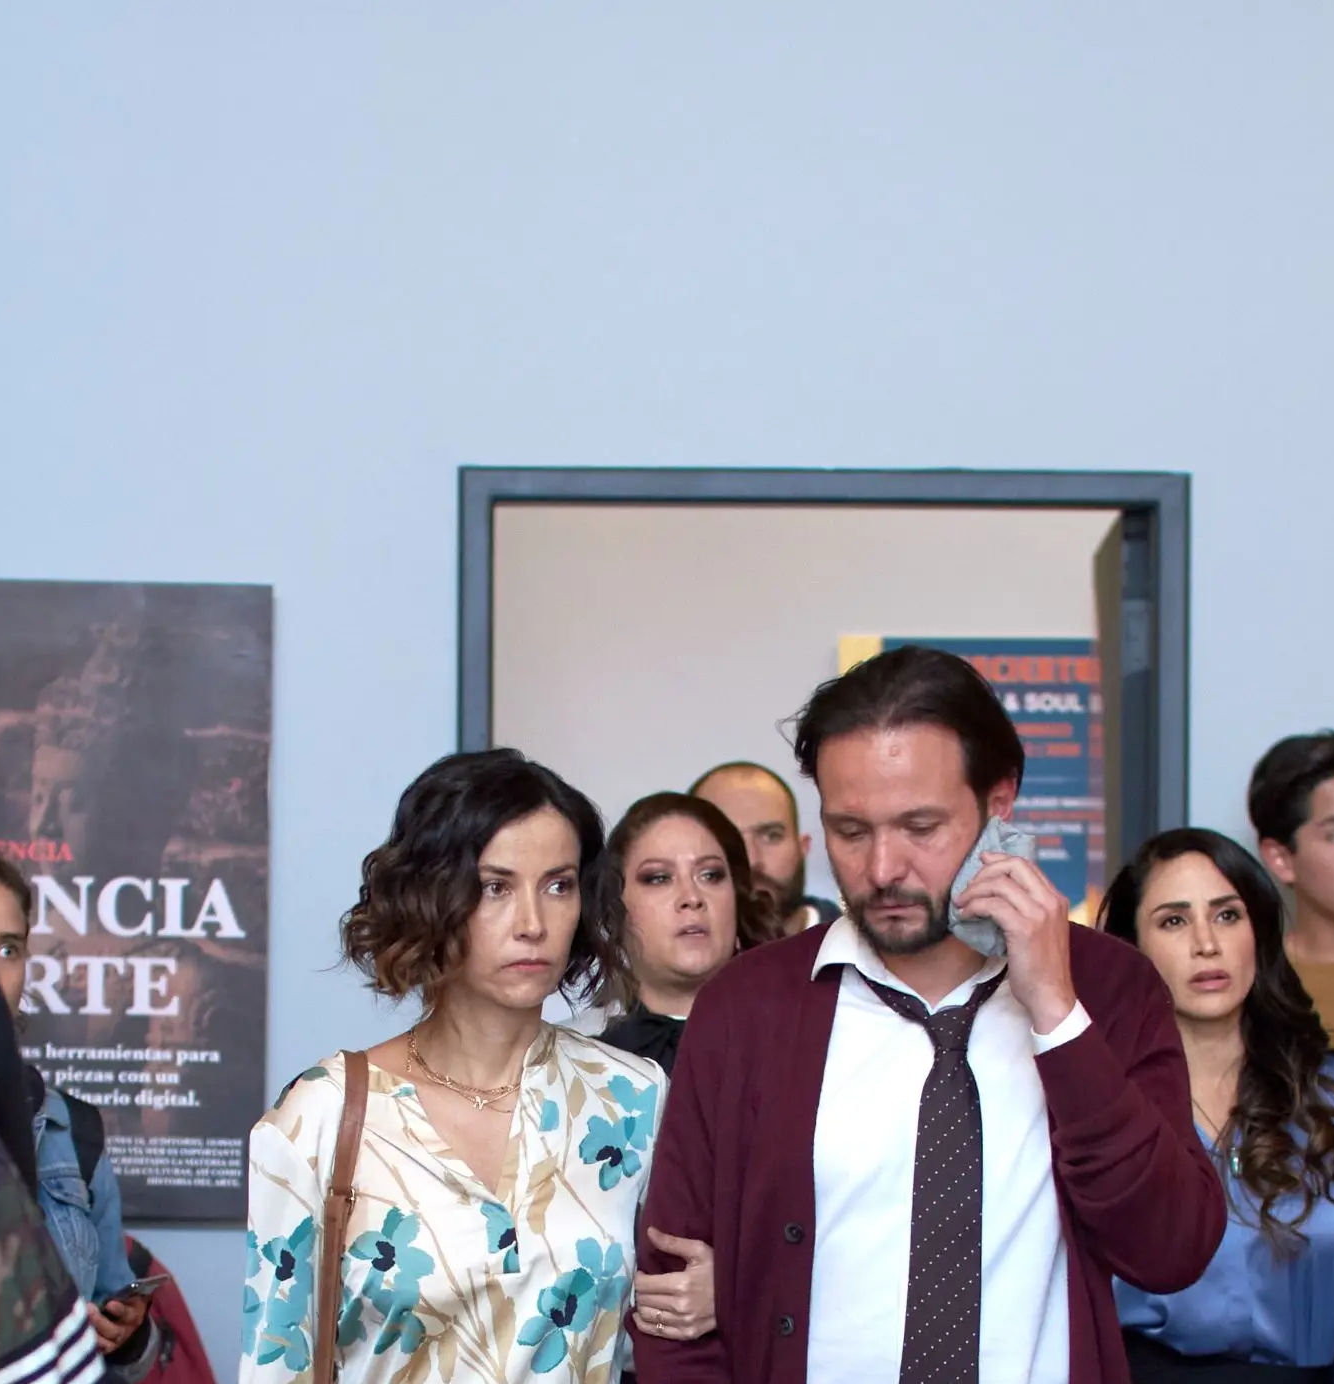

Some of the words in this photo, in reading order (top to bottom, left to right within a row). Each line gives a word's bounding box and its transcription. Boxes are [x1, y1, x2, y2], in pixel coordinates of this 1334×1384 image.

[1023, 691, 1084, 713] SOUL
[30, 875, 246, 939] NCIA
[45, 1041, 172, 1061] herramientas
[175, 1050, 221, 1068] para
[54, 1065, 114, 1087] piezas
[117, 1071, 151, 1084] con
[154, 1072, 180, 1085] un
[133, 1089, 201, 1111] digital.
